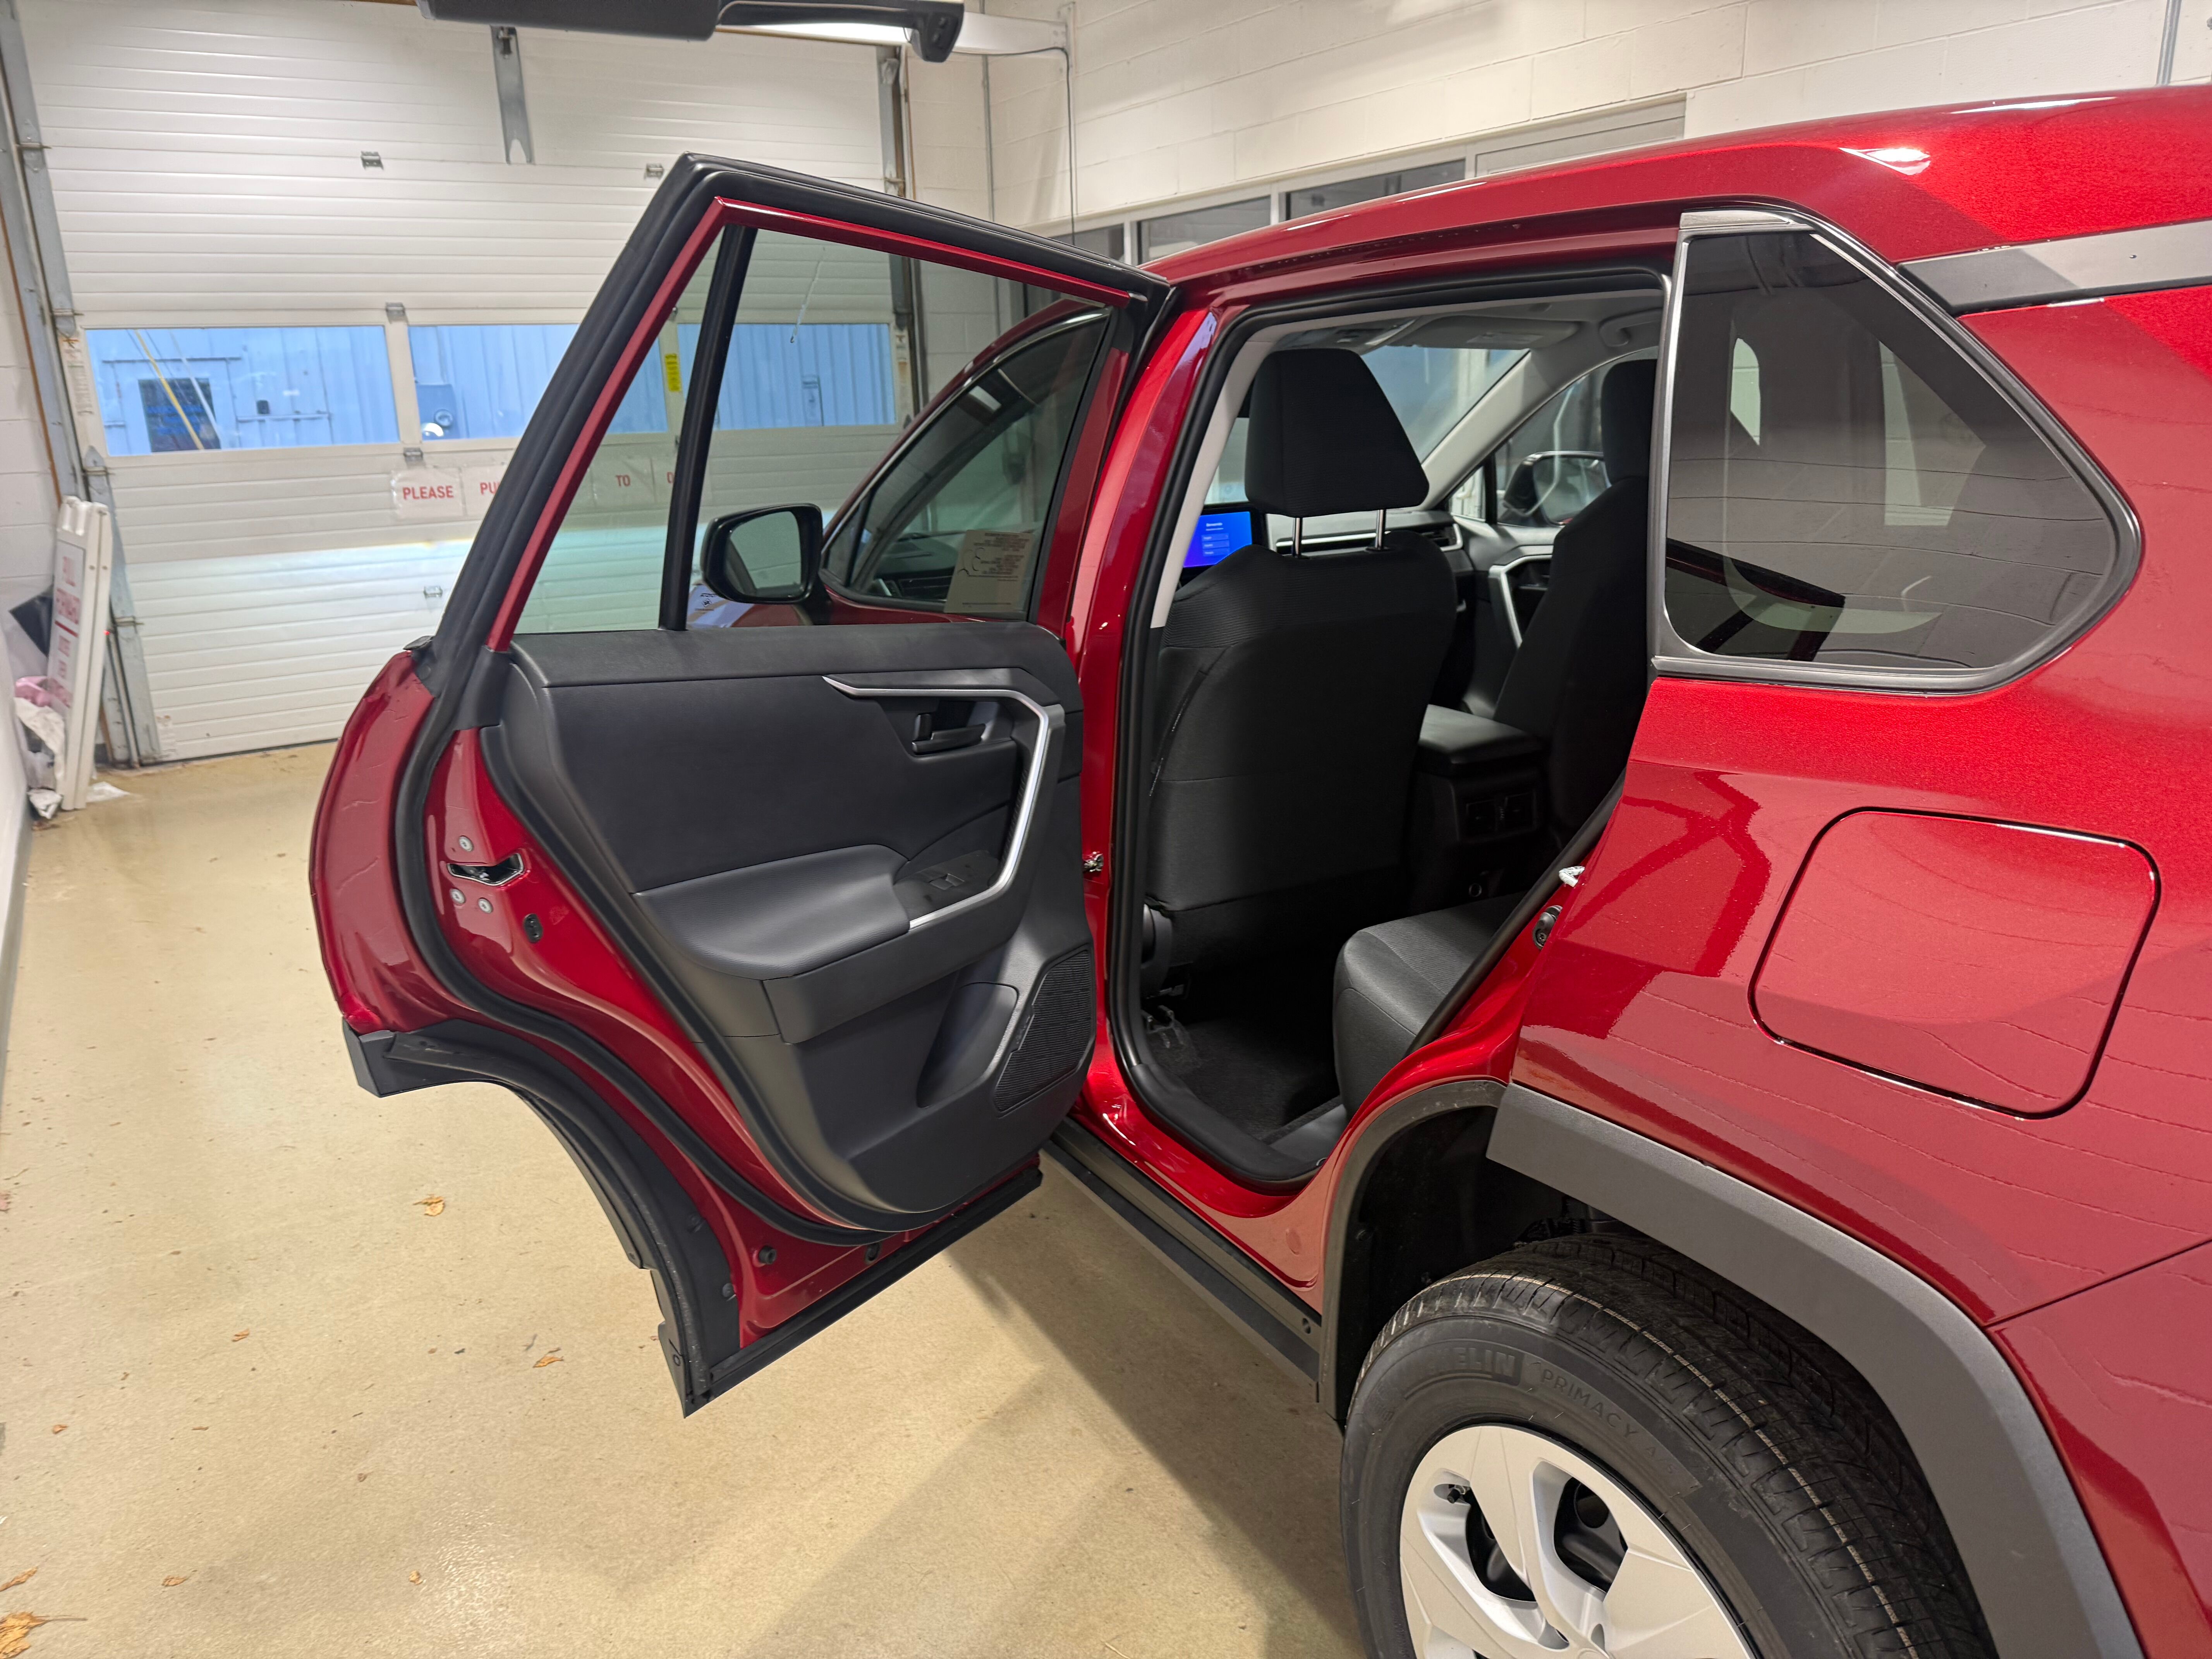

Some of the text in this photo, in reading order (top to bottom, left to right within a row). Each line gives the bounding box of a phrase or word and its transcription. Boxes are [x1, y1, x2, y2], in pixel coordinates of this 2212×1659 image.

[403, 486, 454, 500] PLEASE
[616, 474, 631, 486] TO
[1540, 1369, 1638, 1438] PRIMACY
